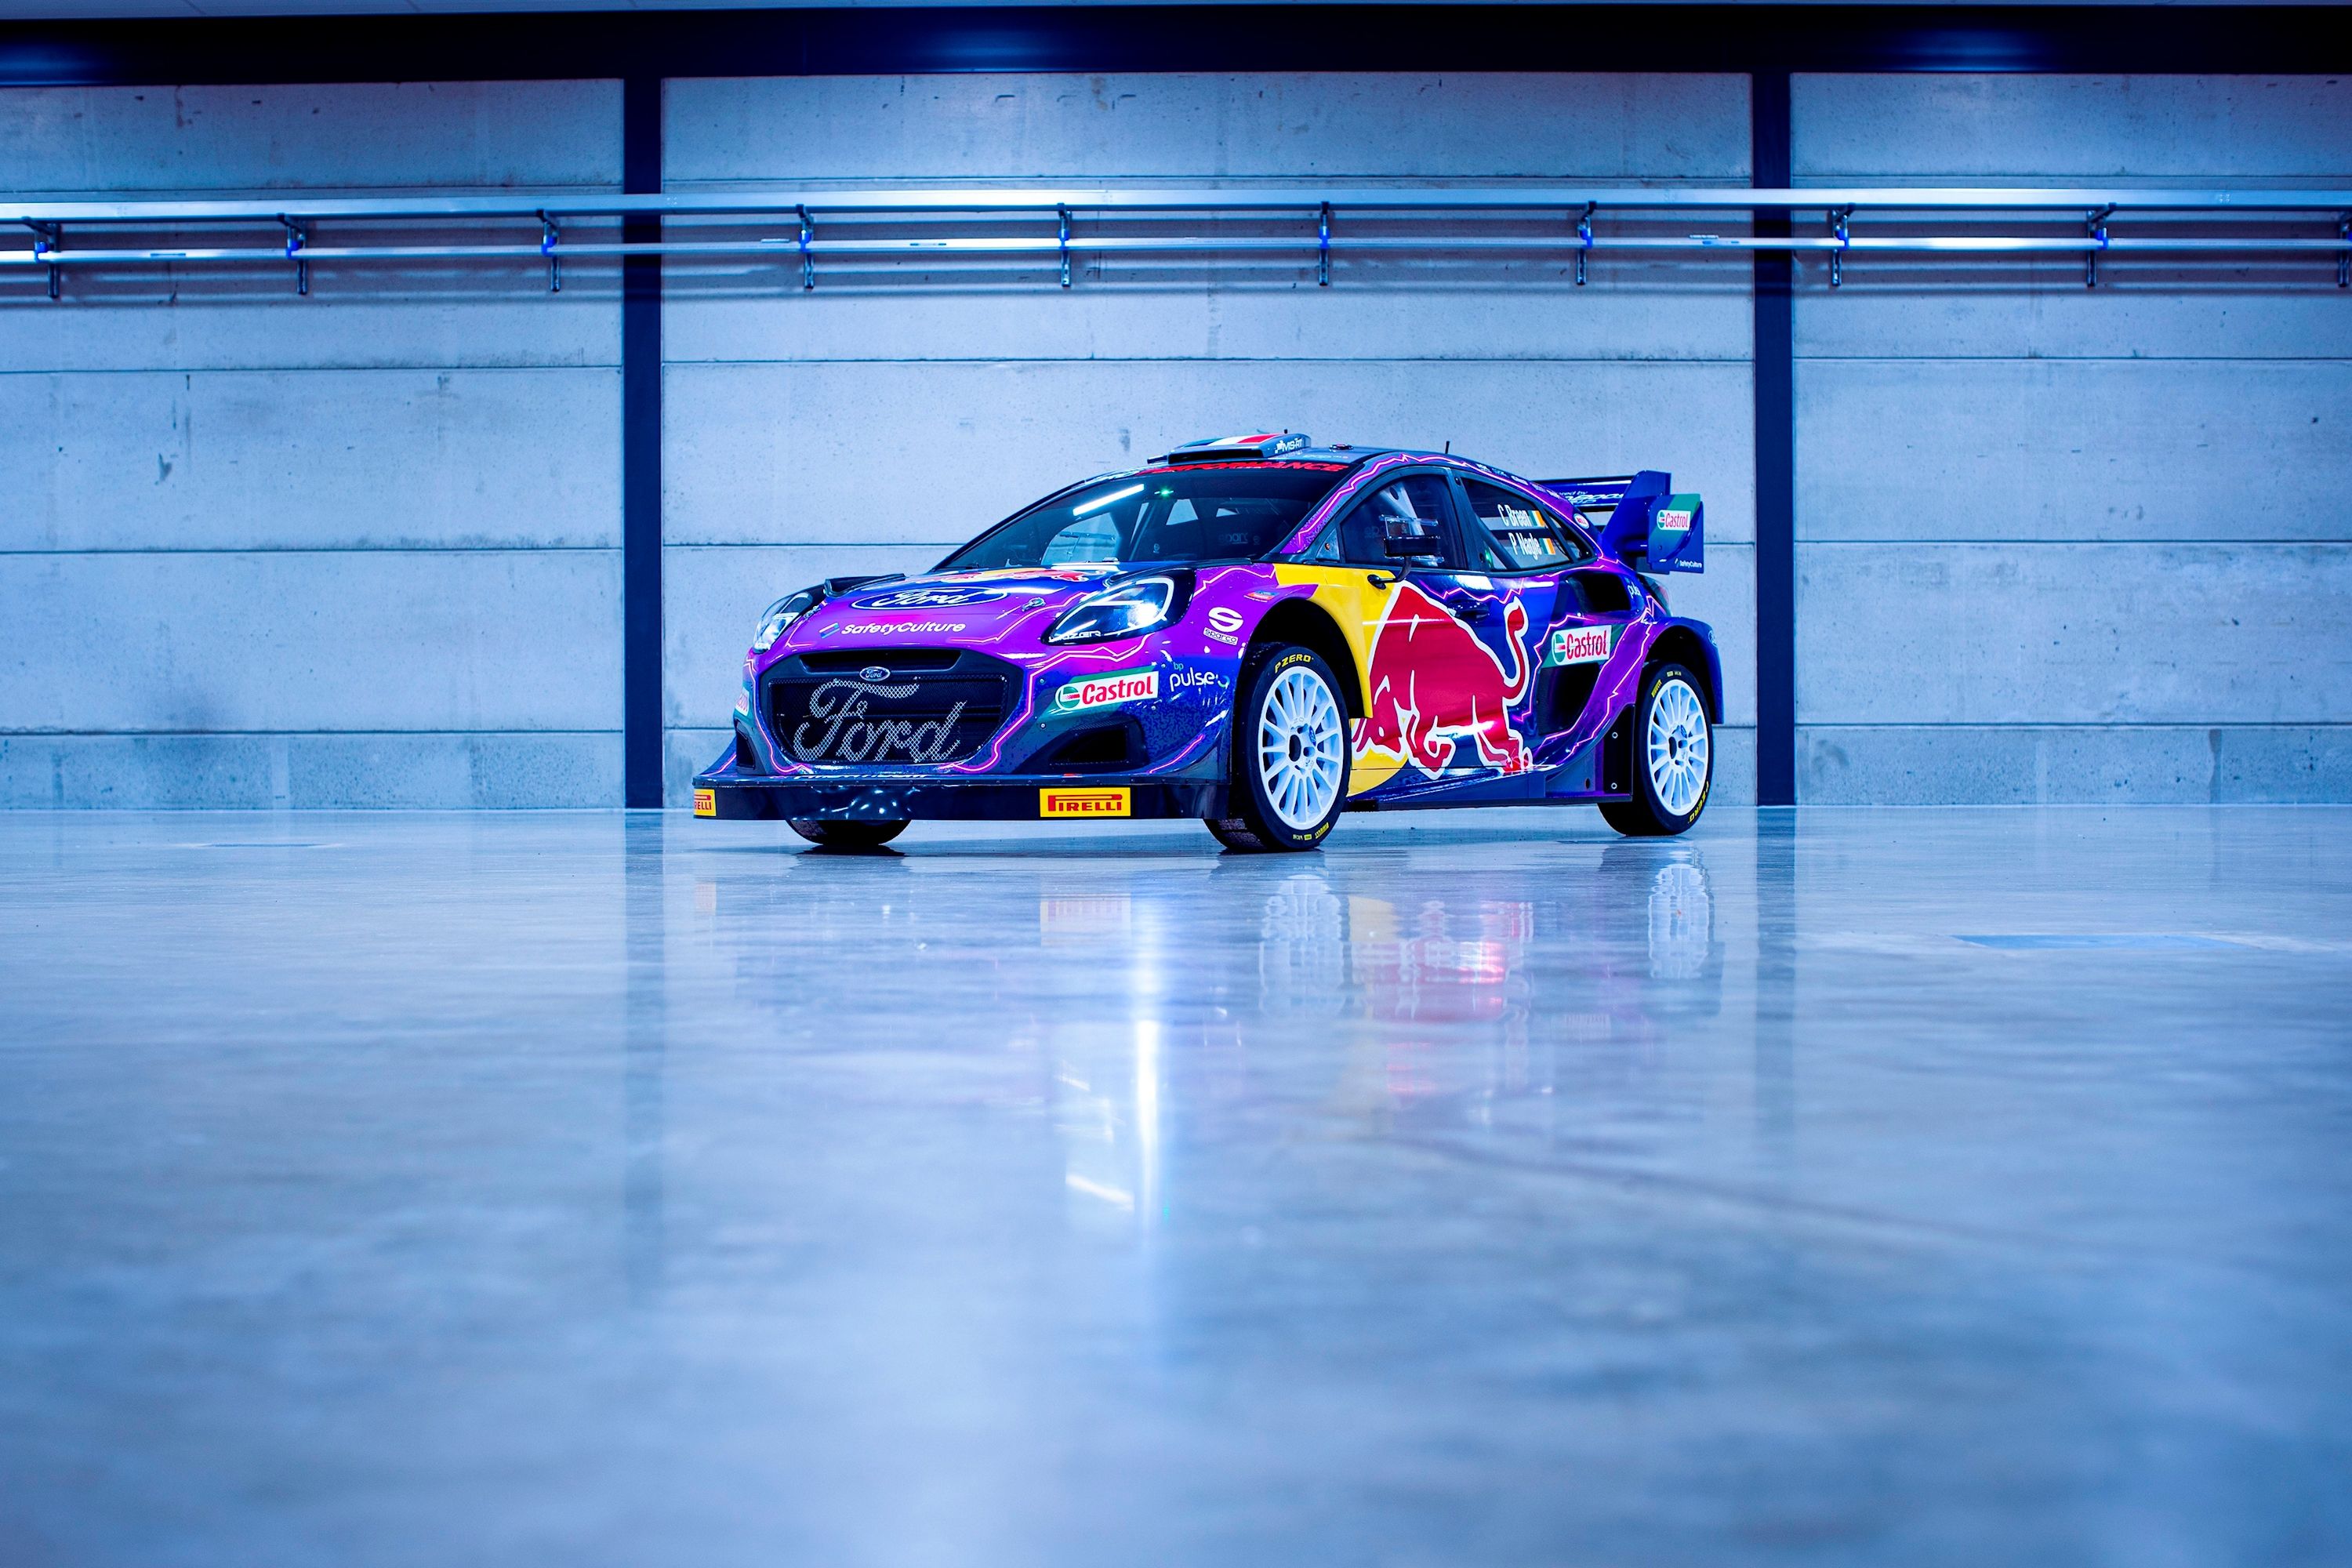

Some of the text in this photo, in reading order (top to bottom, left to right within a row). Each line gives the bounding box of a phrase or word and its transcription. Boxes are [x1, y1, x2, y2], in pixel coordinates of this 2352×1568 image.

[1497, 504, 1532, 527] C Breen
[1665, 513, 1689, 528] Castrol
[1508, 532, 1518, 555] P
[871, 588, 985, 607] Ford
[841, 621, 967, 636] SafetyCulture
[1204, 629, 1237, 644] sparco
[1566, 630, 1607, 659] Castrol
[865, 668, 883, 679] Ford
[1173, 662, 1184, 672] bp
[1169, 666, 1215, 692] pulse
[1081, 675, 1154, 706] Castrol
[793, 678, 967, 763] Ford
[1047, 793, 1123, 812] PIRELLI
